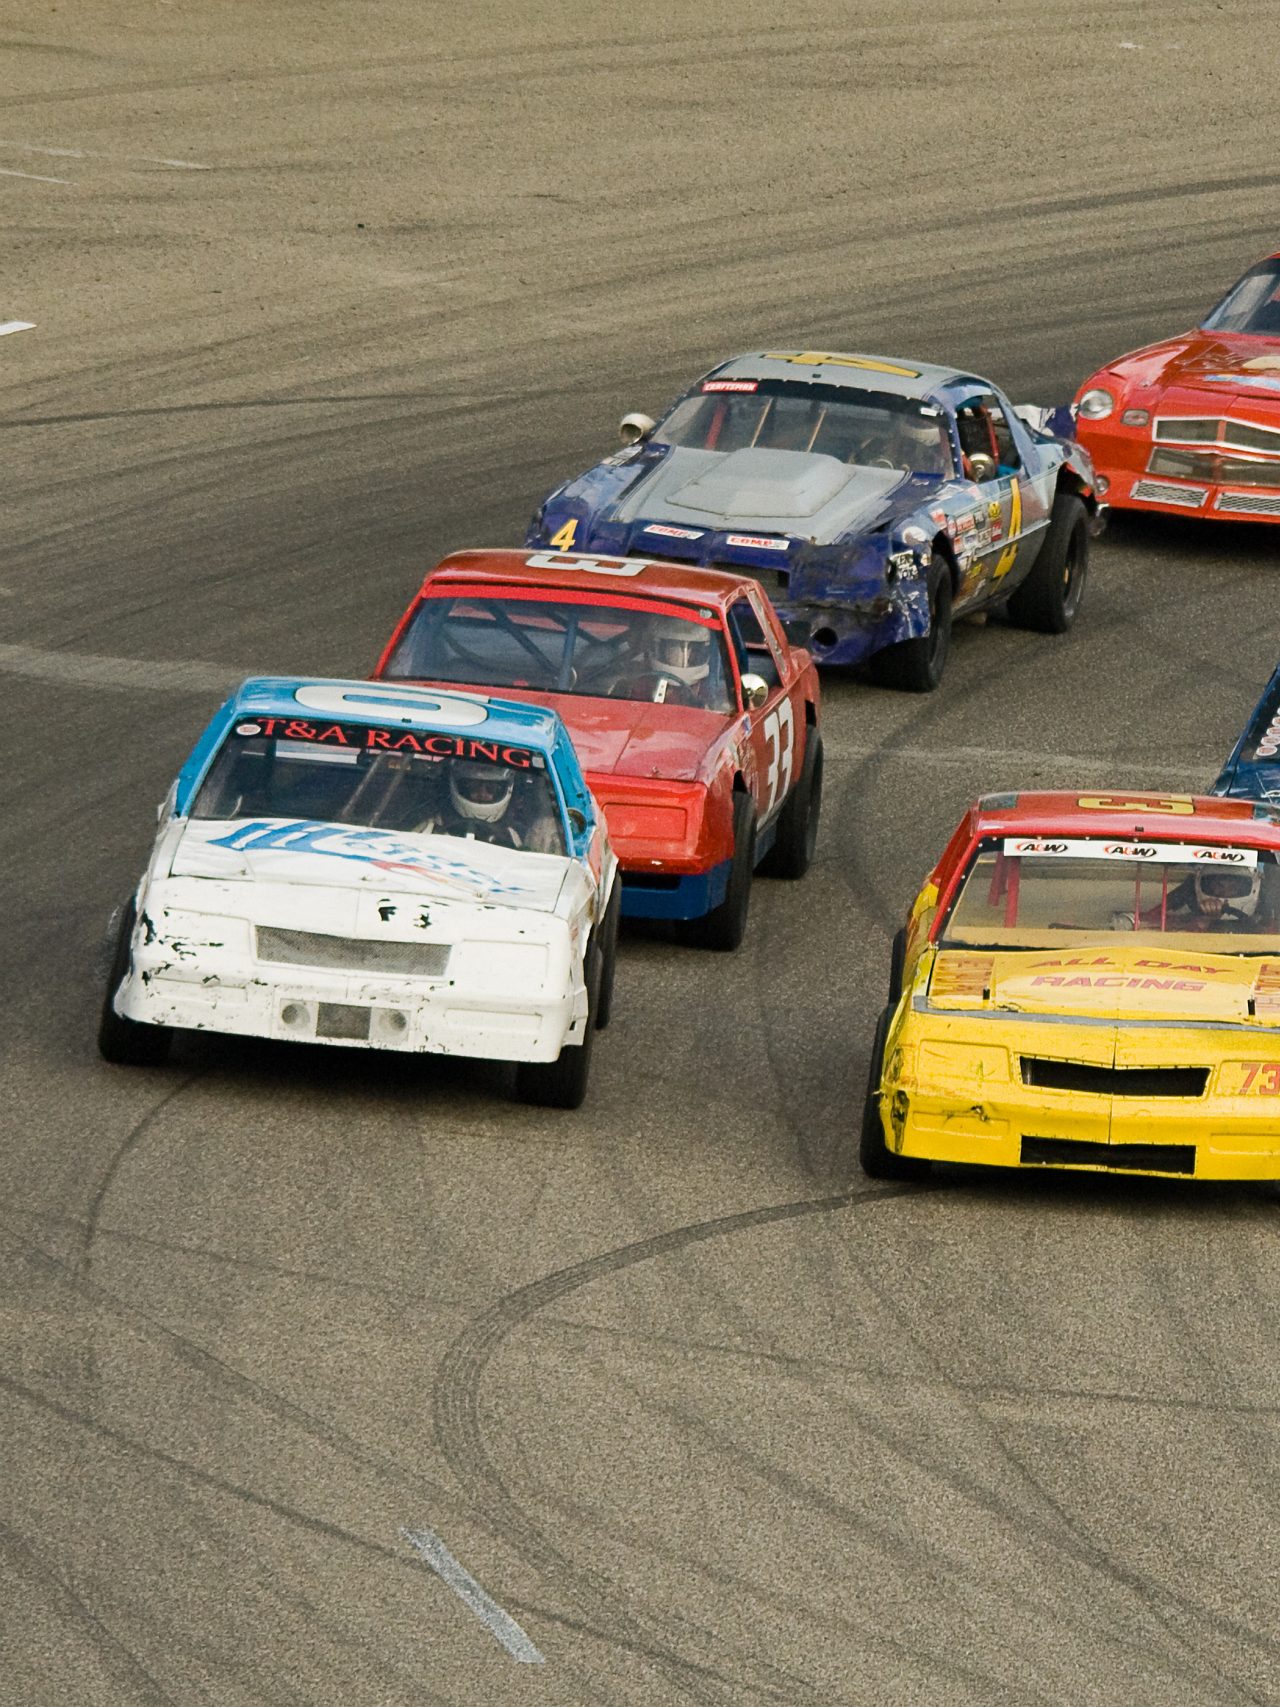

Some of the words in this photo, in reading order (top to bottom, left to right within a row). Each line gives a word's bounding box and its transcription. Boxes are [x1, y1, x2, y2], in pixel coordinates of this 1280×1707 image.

[703, 381, 757, 391] CRAFTSMAN
[551, 518, 578, 552] 4
[256, 718, 349, 745] T&A
[366, 729, 532, 769] RACING
[757, 697, 794, 831] 33
[1019, 842, 1065, 854] A&W
[1108, 845, 1154, 857] A&W
[1198, 850, 1243, 862] A&W
[1027, 956, 1115, 968] ALL
[1134, 958, 1237, 974] DAY
[1031, 975, 1207, 993] RACING
